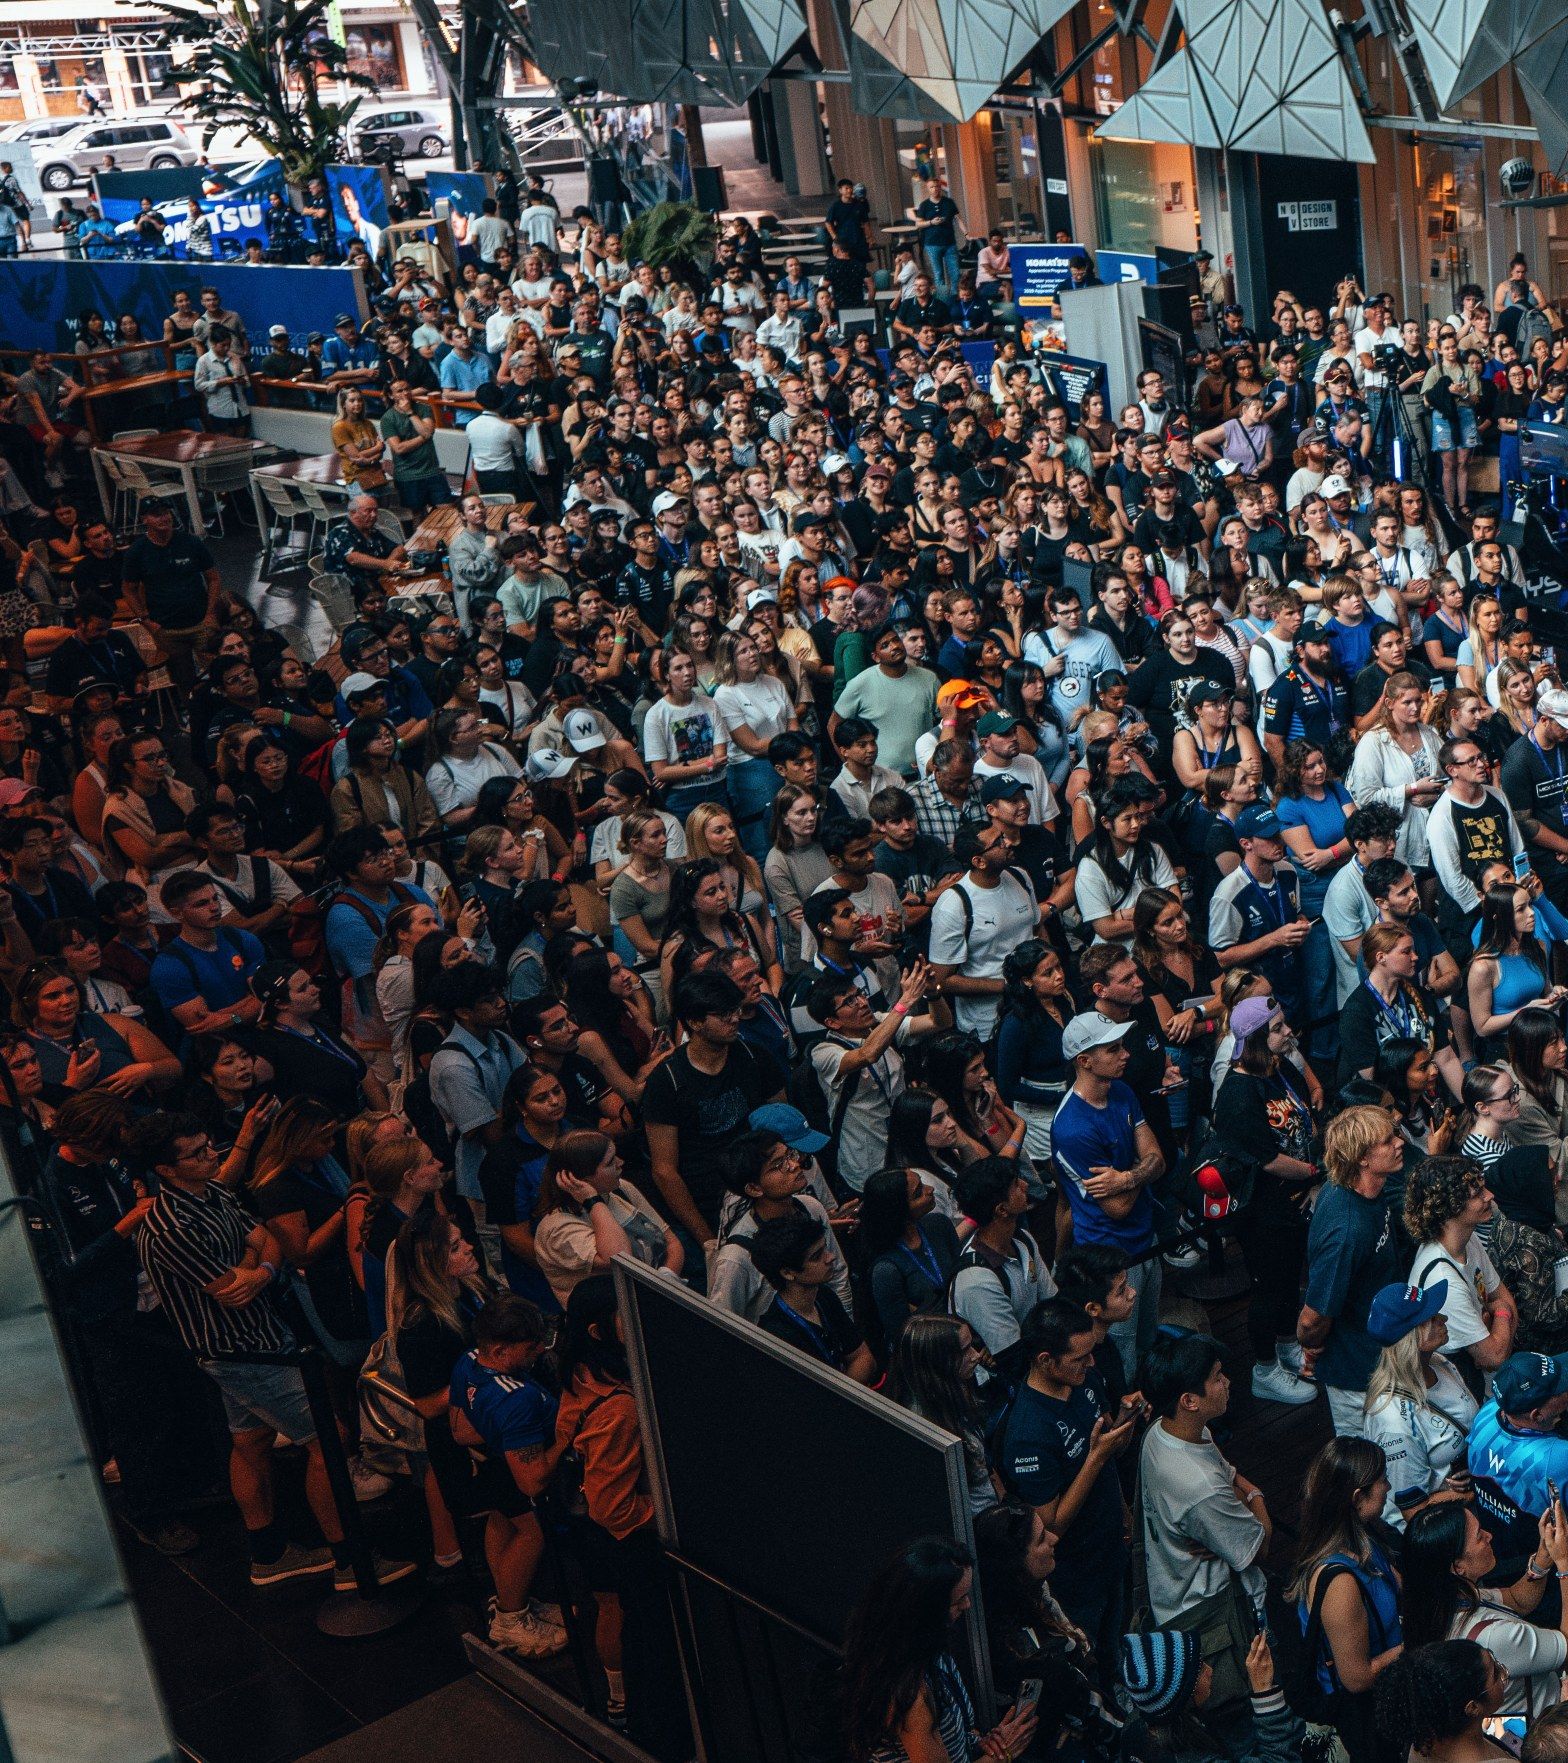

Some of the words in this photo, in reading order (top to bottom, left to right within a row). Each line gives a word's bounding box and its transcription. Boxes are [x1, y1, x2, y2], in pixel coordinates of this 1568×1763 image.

[1301, 203, 1333, 214] DESIGN
[1302, 216, 1330, 228] STORE
[576, 721, 591, 737] W
[544, 750, 560, 762] W
[1014, 1456, 1039, 1464] Acronis
[1488, 1448, 1506, 1474] W
[1474, 1482, 1517, 1518] WILLIAMS
[1478, 1496, 1511, 1524] RACING
